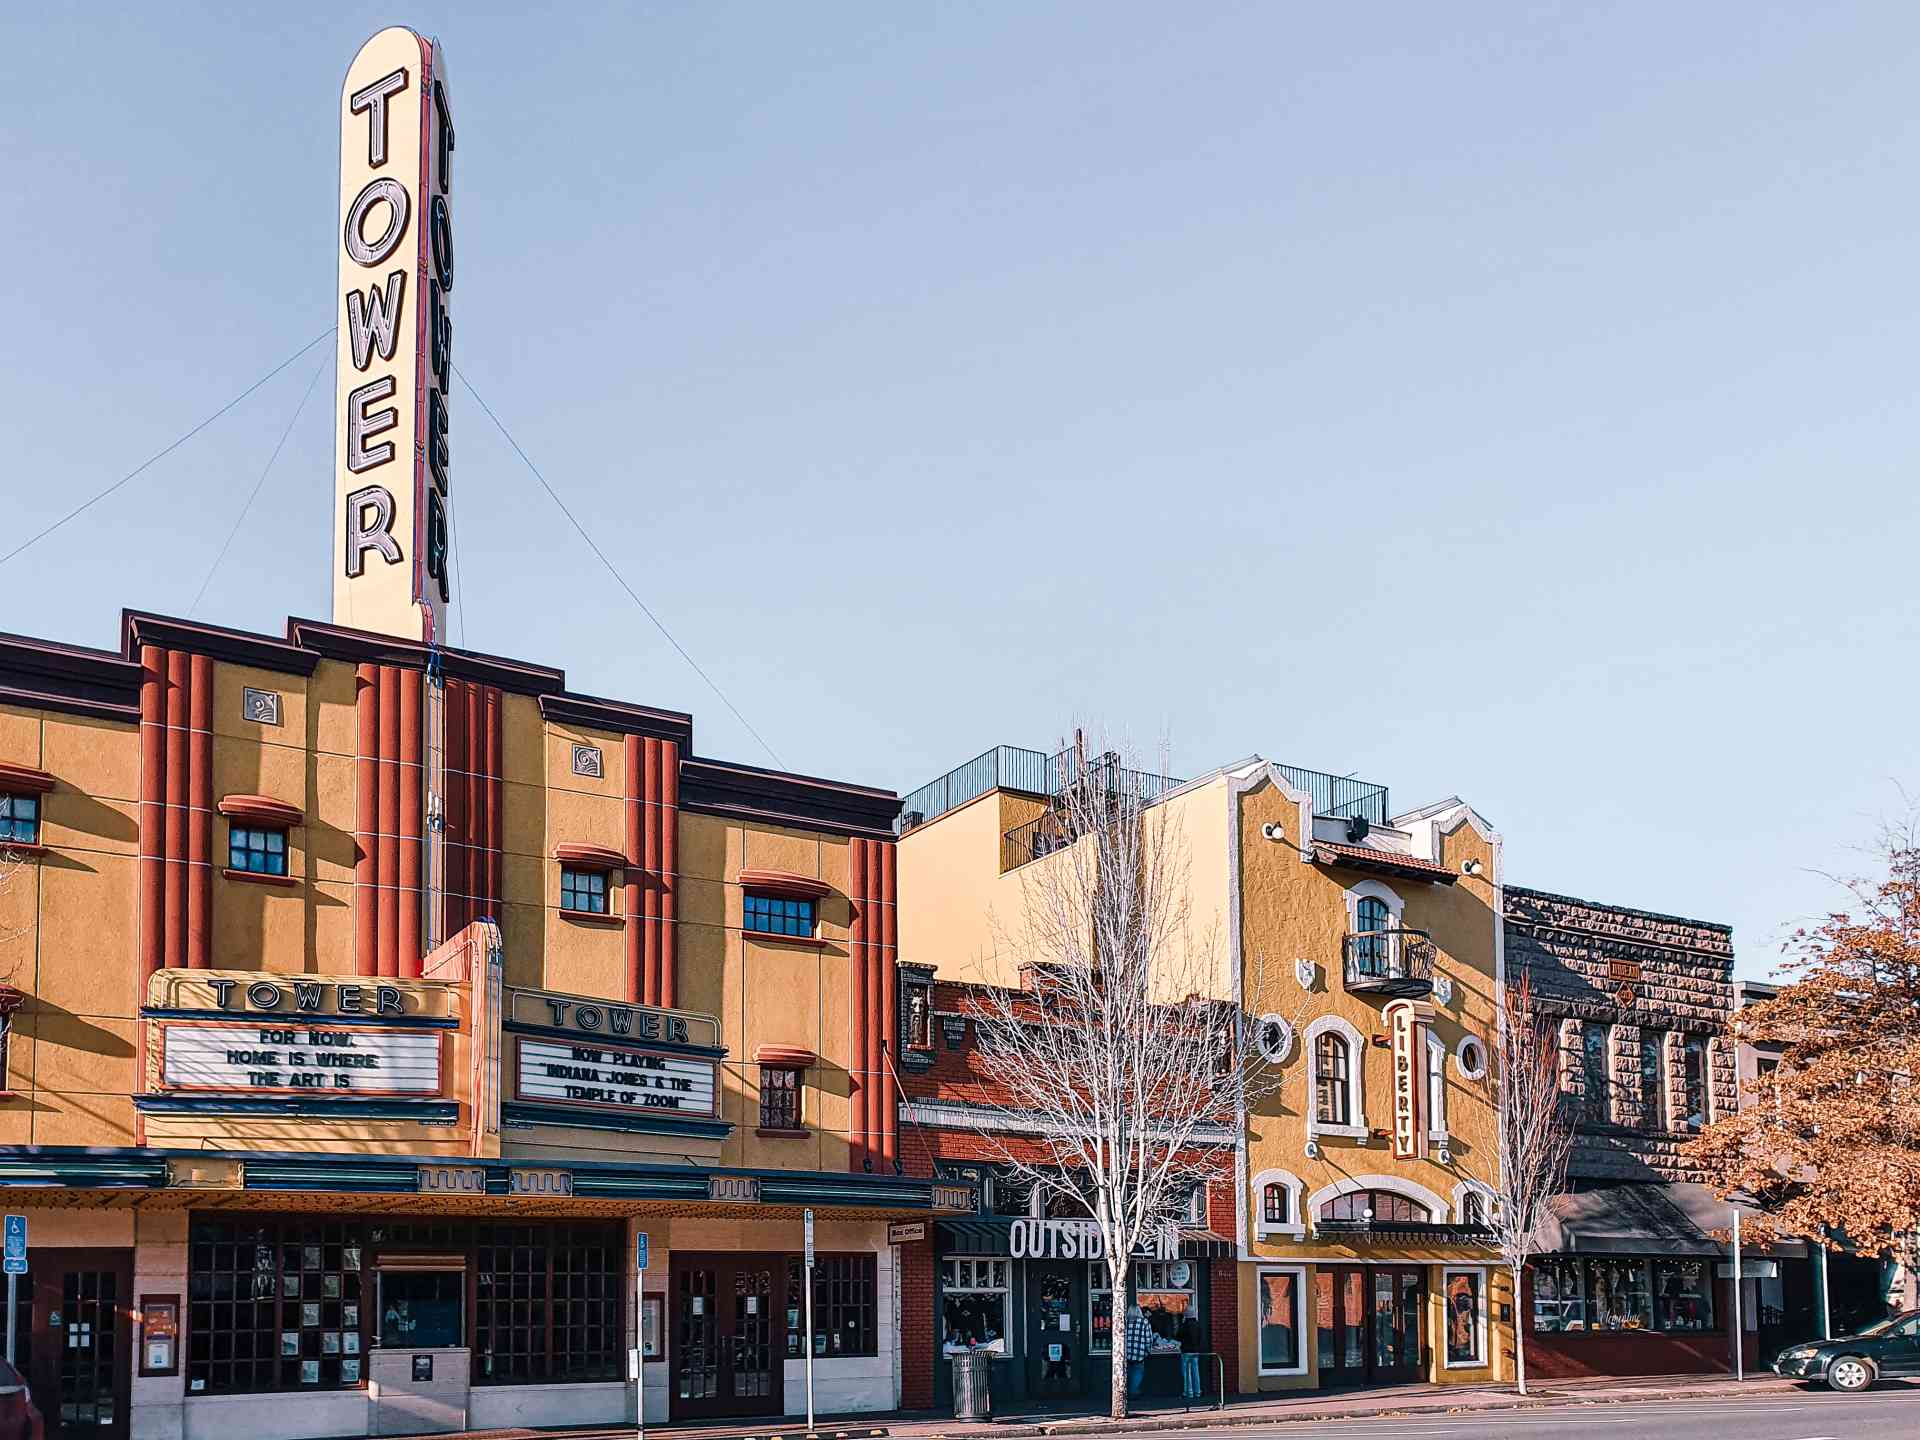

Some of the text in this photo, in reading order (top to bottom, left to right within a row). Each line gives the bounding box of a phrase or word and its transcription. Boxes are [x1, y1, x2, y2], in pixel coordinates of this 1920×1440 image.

[344, 66, 411, 579] TOWER
[208, 979, 405, 1015] TOWER
[546, 999, 690, 1043] TOWER
[260, 1029, 296, 1045] FOR
[226, 1049, 380, 1070] HOME IS WHERE
[572, 1048, 602, 1063] NOW
[248, 1071, 351, 1088] THE ART IS
[606, 1070, 648, 1087] JONES
[670, 1077, 693, 1092] THE
[1396, 1015, 1410, 1152] LIBERTY
[564, 1085, 617, 1103] TEMPLE
[620, 1090, 636, 1105] OF
[1010, 1219, 1116, 1259] OUTSID
